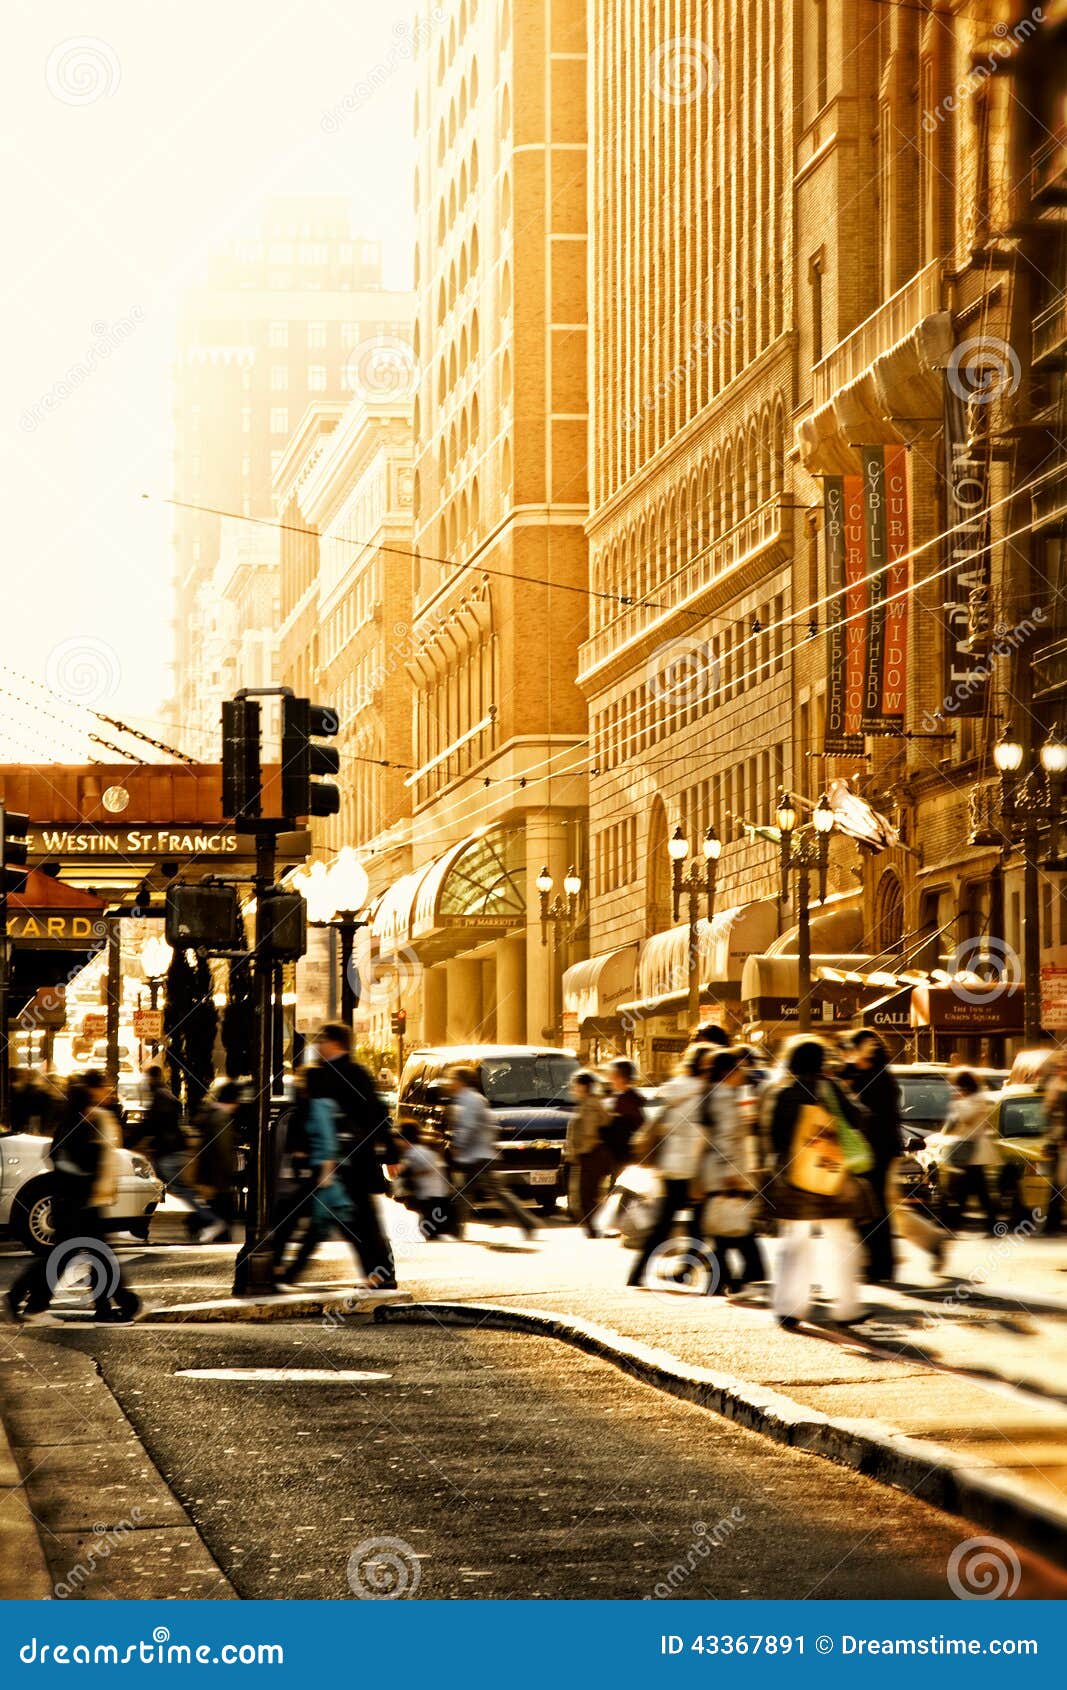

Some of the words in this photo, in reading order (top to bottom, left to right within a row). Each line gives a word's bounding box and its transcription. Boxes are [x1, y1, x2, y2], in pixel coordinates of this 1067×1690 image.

[828, 489, 841, 584] CYBILL
[848, 504, 864, 610] CURVY
[867, 461, 881, 558] CYBILL
[890, 476, 905, 584] CURVY
[848, 627, 865, 732] WIDOW
[886, 602, 906, 709] WIDOW
